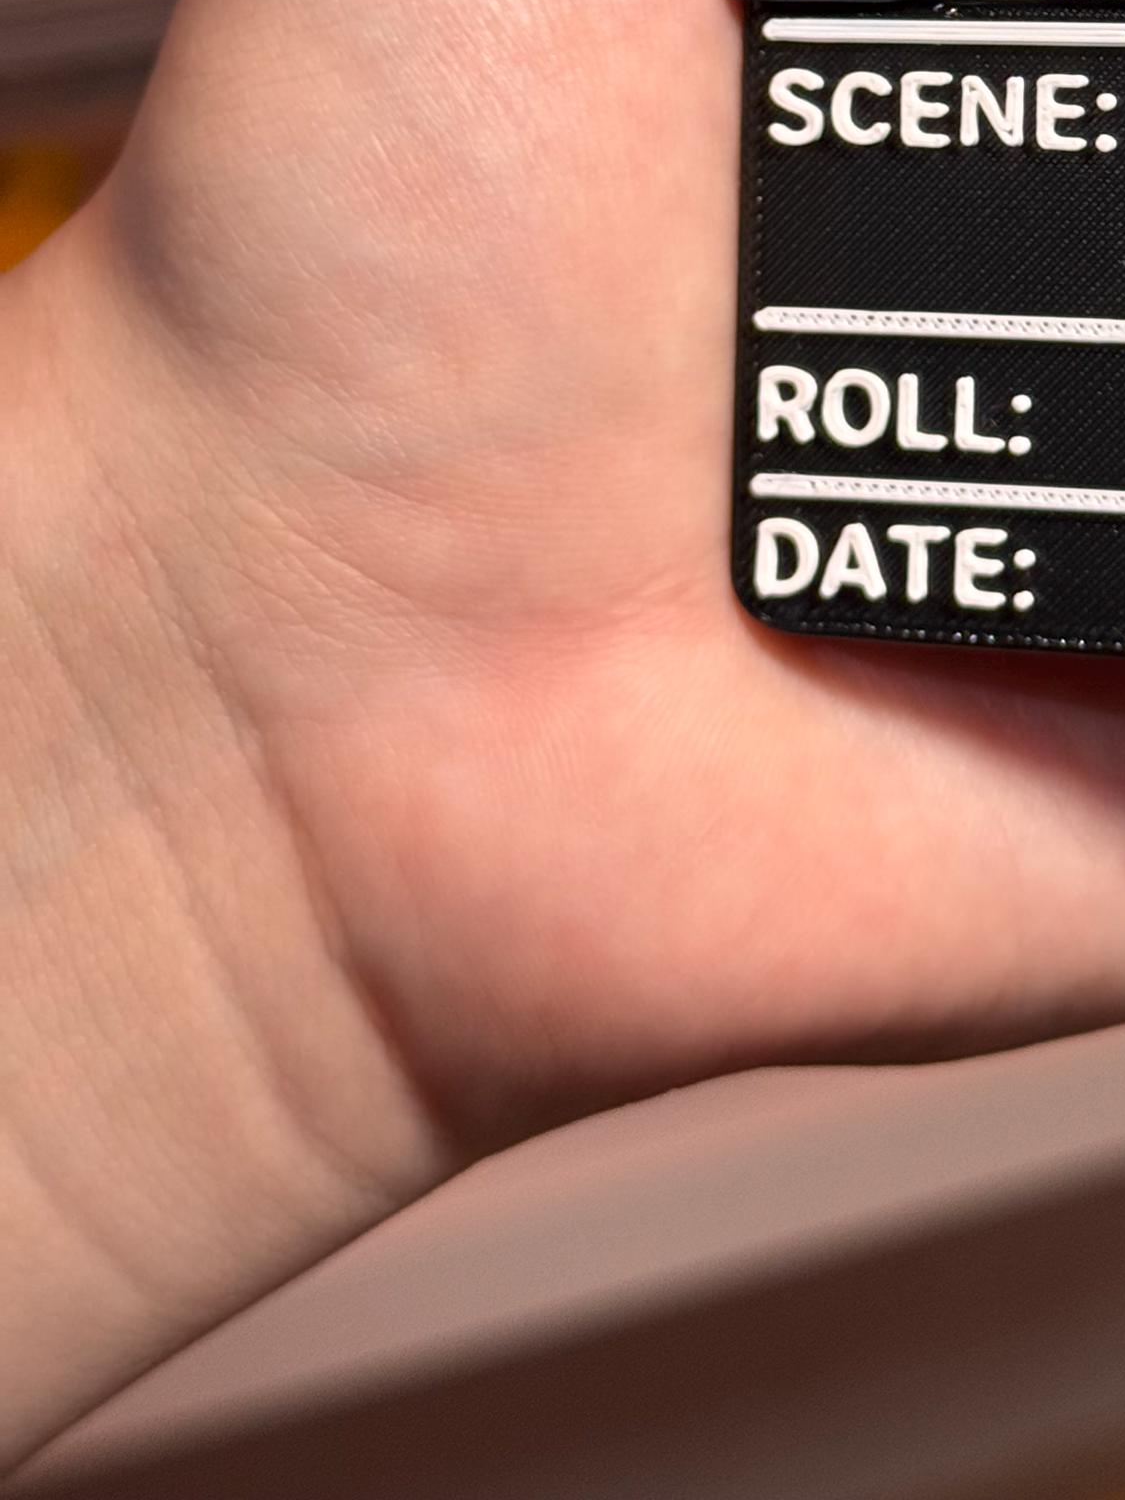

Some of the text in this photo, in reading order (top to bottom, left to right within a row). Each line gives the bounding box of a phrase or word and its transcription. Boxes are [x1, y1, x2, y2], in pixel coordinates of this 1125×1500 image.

[767, 66, 1119, 154] SCENE:
[756, 363, 1034, 456] ROLL:
[753, 516, 1038, 611] DATE:
